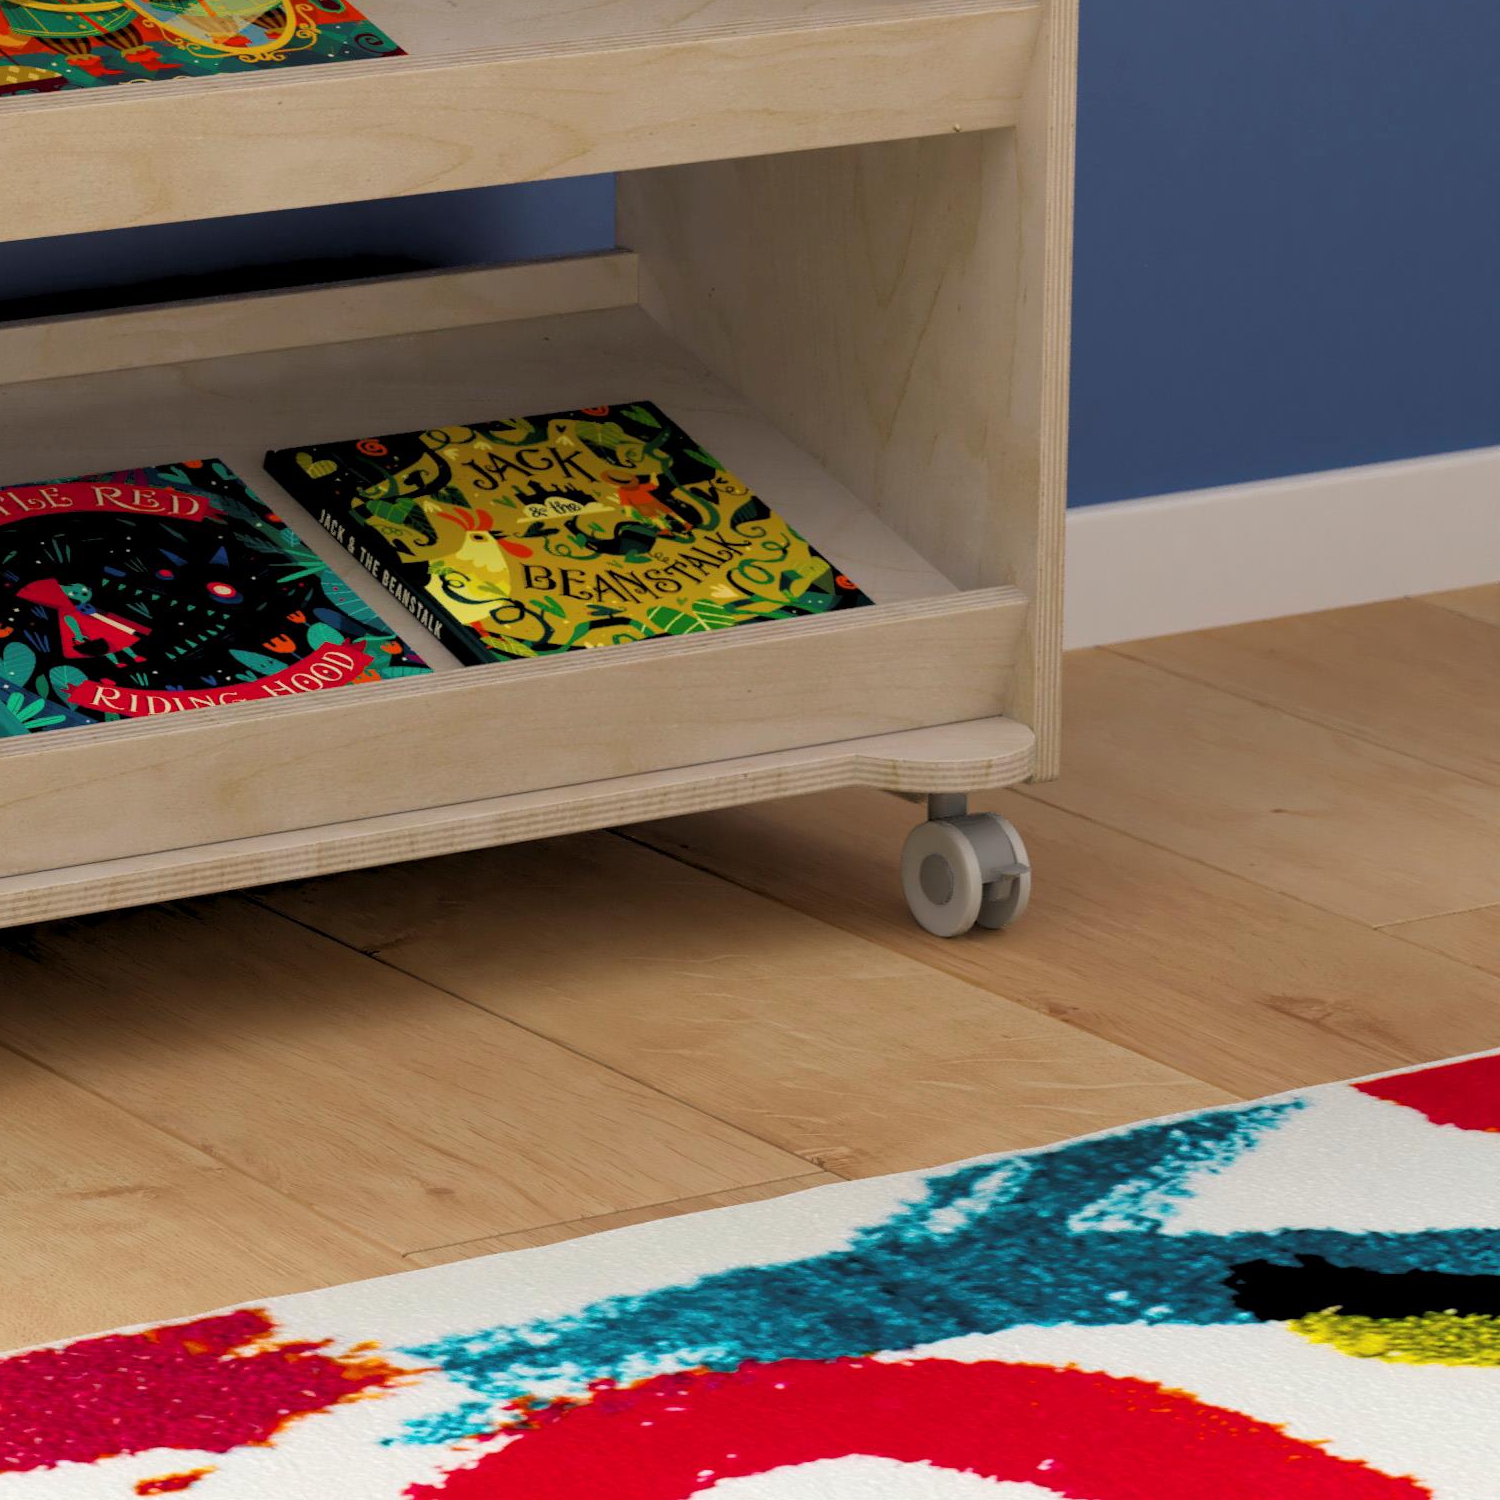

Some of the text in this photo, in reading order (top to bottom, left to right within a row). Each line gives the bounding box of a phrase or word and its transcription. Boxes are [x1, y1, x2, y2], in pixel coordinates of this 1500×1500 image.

[461, 446, 600, 491] JACK
[90, 485, 200, 515] RED
[549, 500, 582, 515] the
[319, 508, 443, 639] JACK & THE BEANSTALK
[519, 531, 752, 604] BEANSTALK
